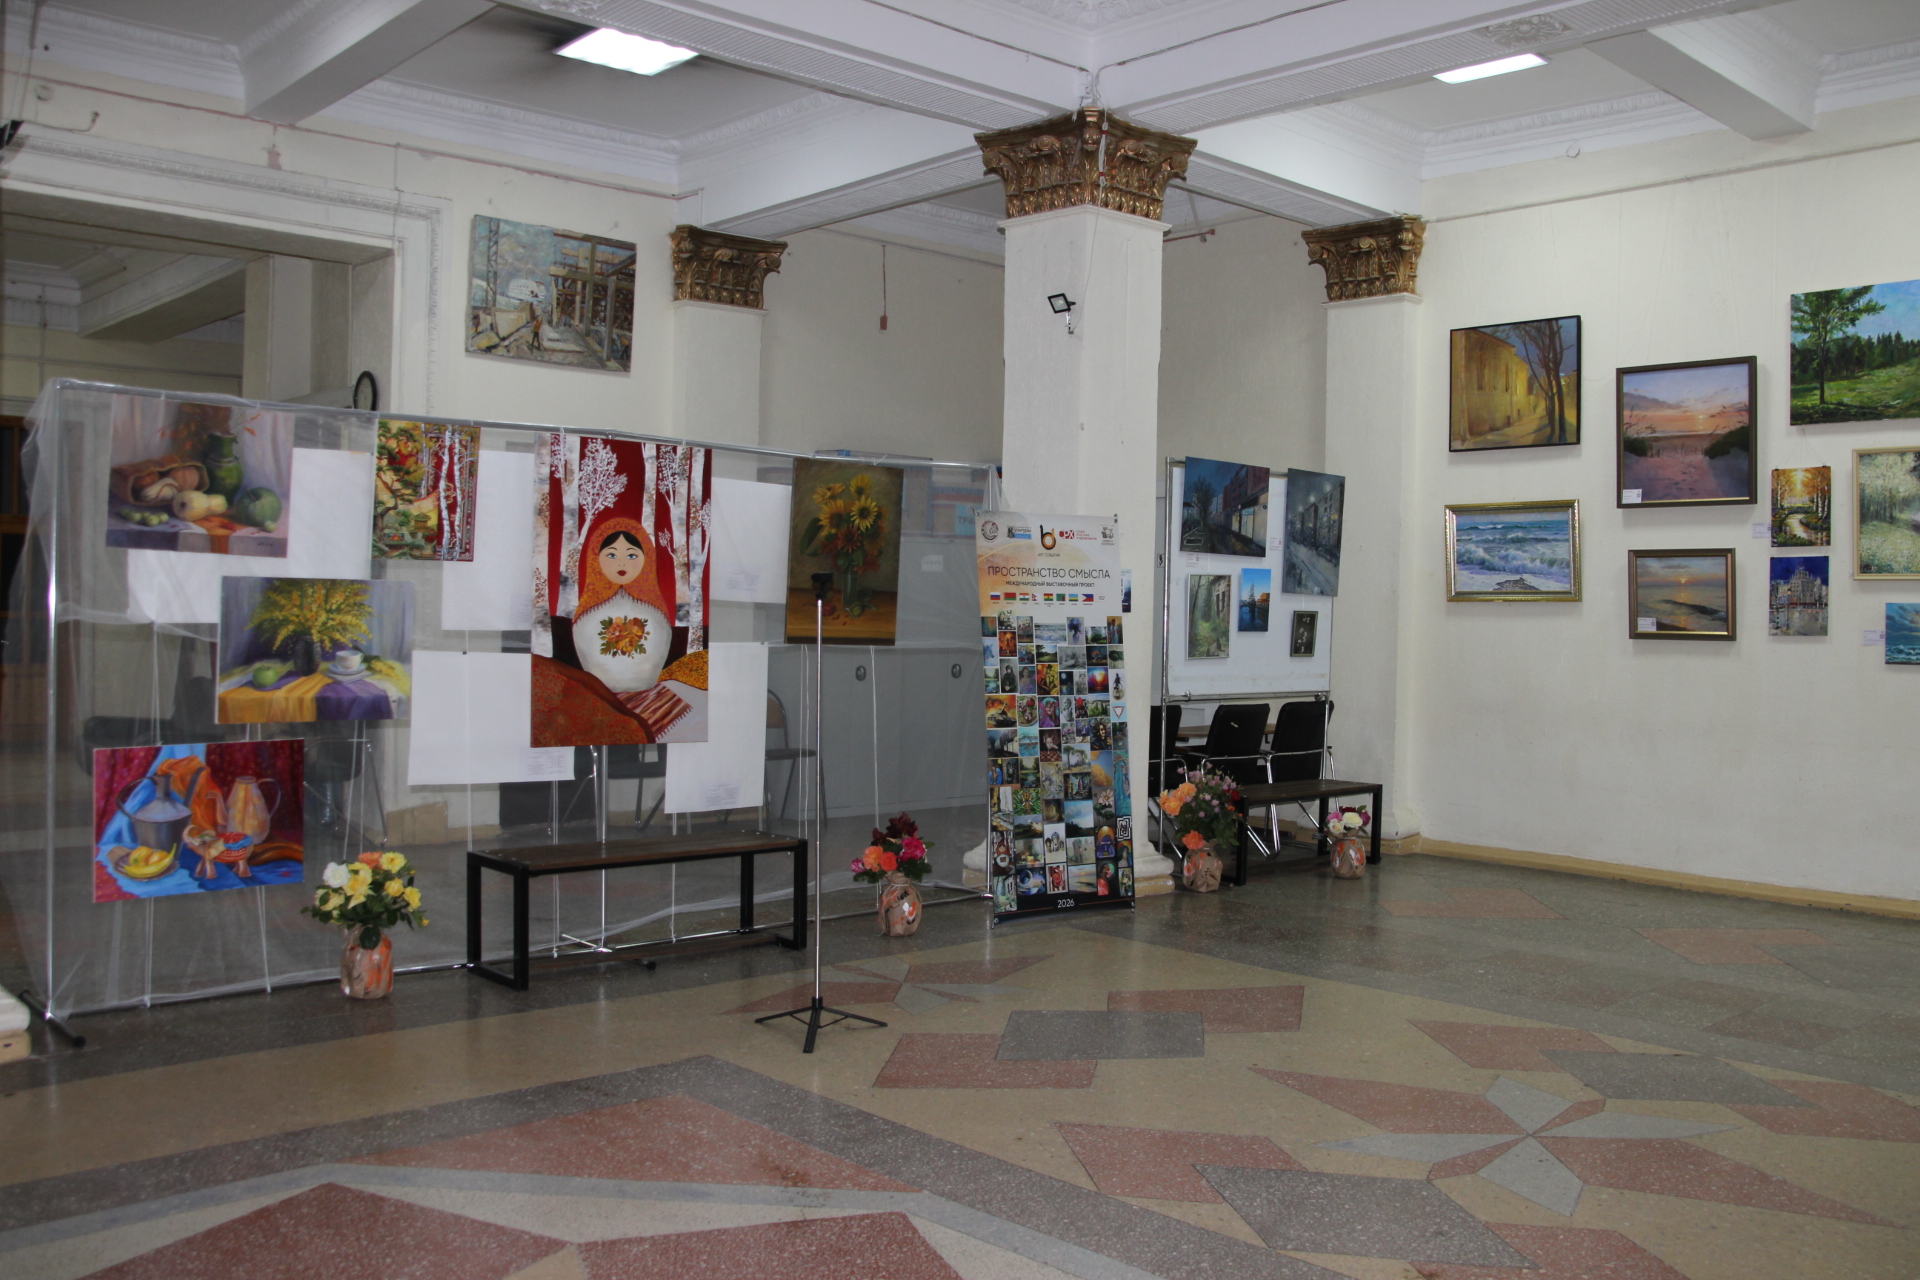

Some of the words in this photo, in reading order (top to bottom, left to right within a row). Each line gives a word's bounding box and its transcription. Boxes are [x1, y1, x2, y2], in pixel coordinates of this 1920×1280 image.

[988, 566, 1066, 578] ПРОСТРАНСТВО
[1068, 568, 1111, 579] СМЫСЛА
[1057, 899, 1075, 908] 2026
